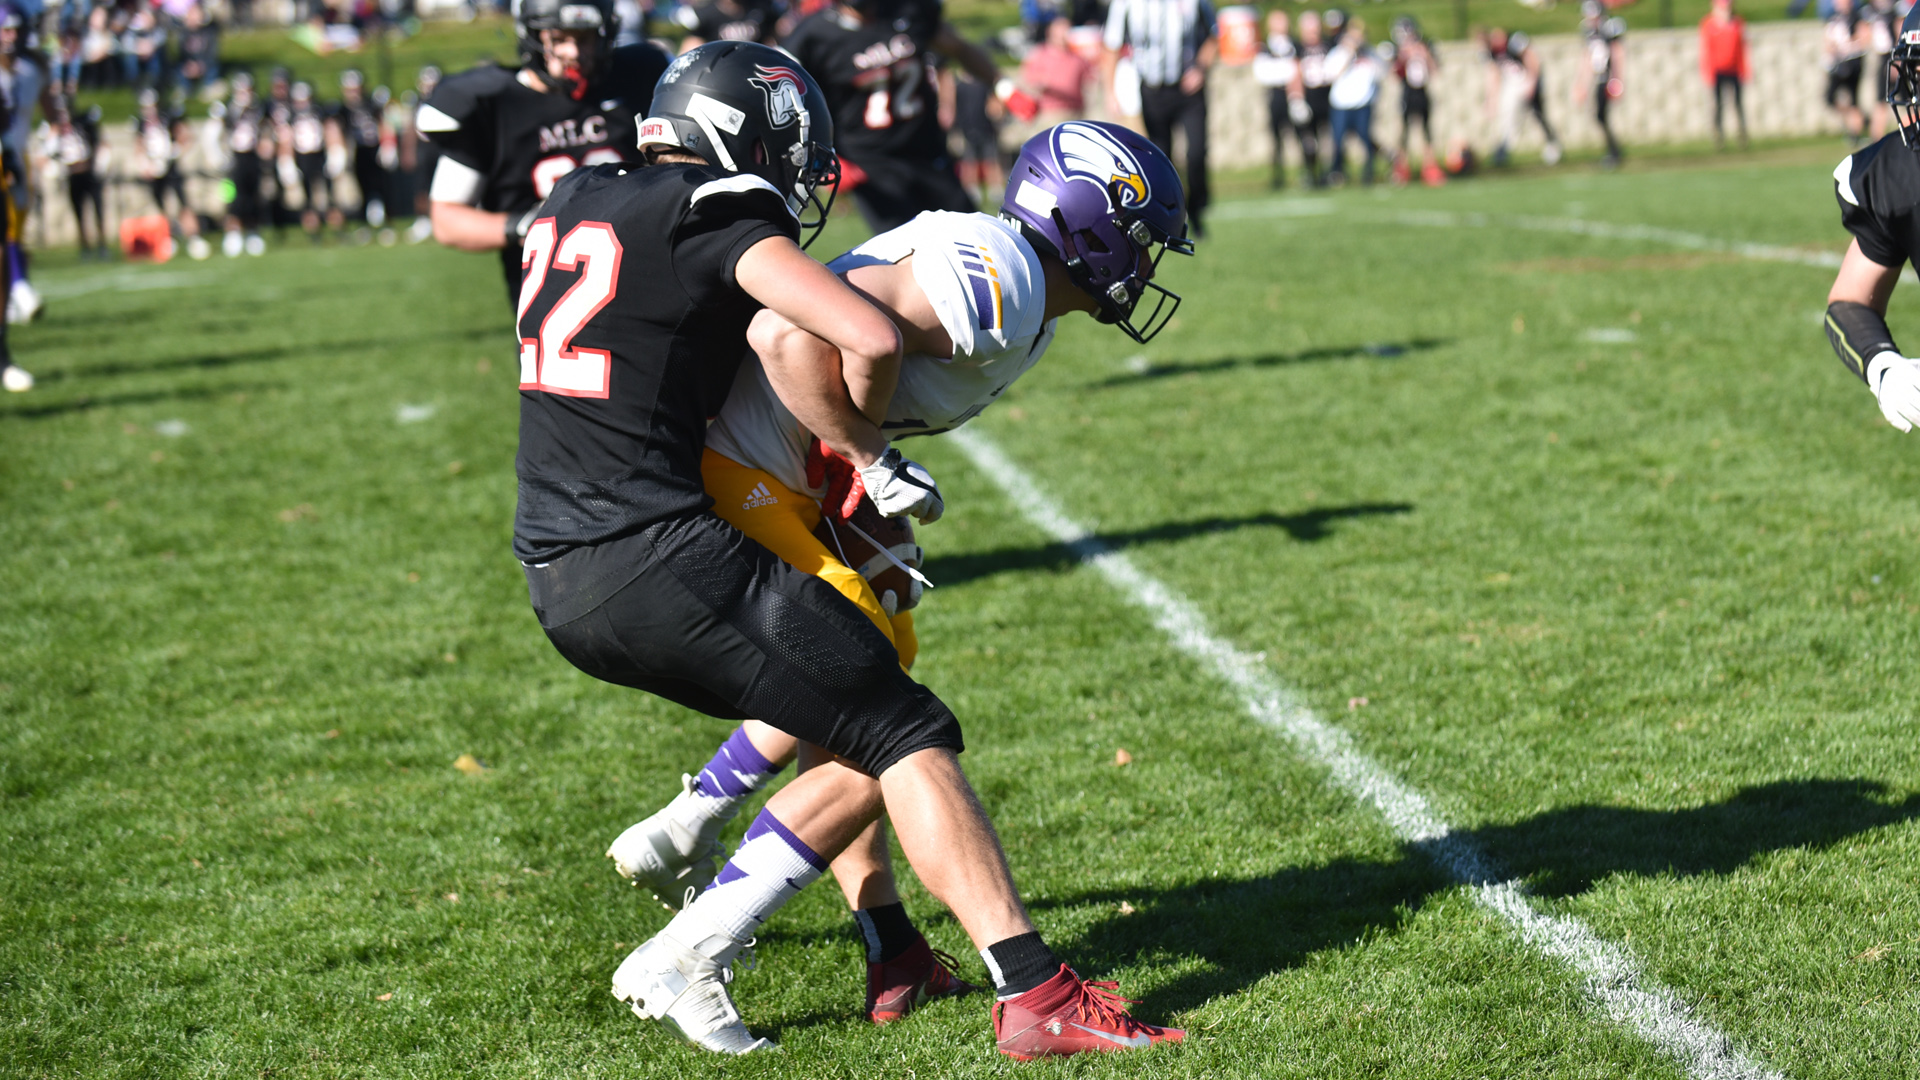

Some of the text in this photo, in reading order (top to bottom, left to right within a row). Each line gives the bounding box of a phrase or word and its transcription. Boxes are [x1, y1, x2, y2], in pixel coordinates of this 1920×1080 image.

[539, 115, 608, 153] MLC
[516, 216, 624, 399] 22
[742, 496, 778, 510] adidas
